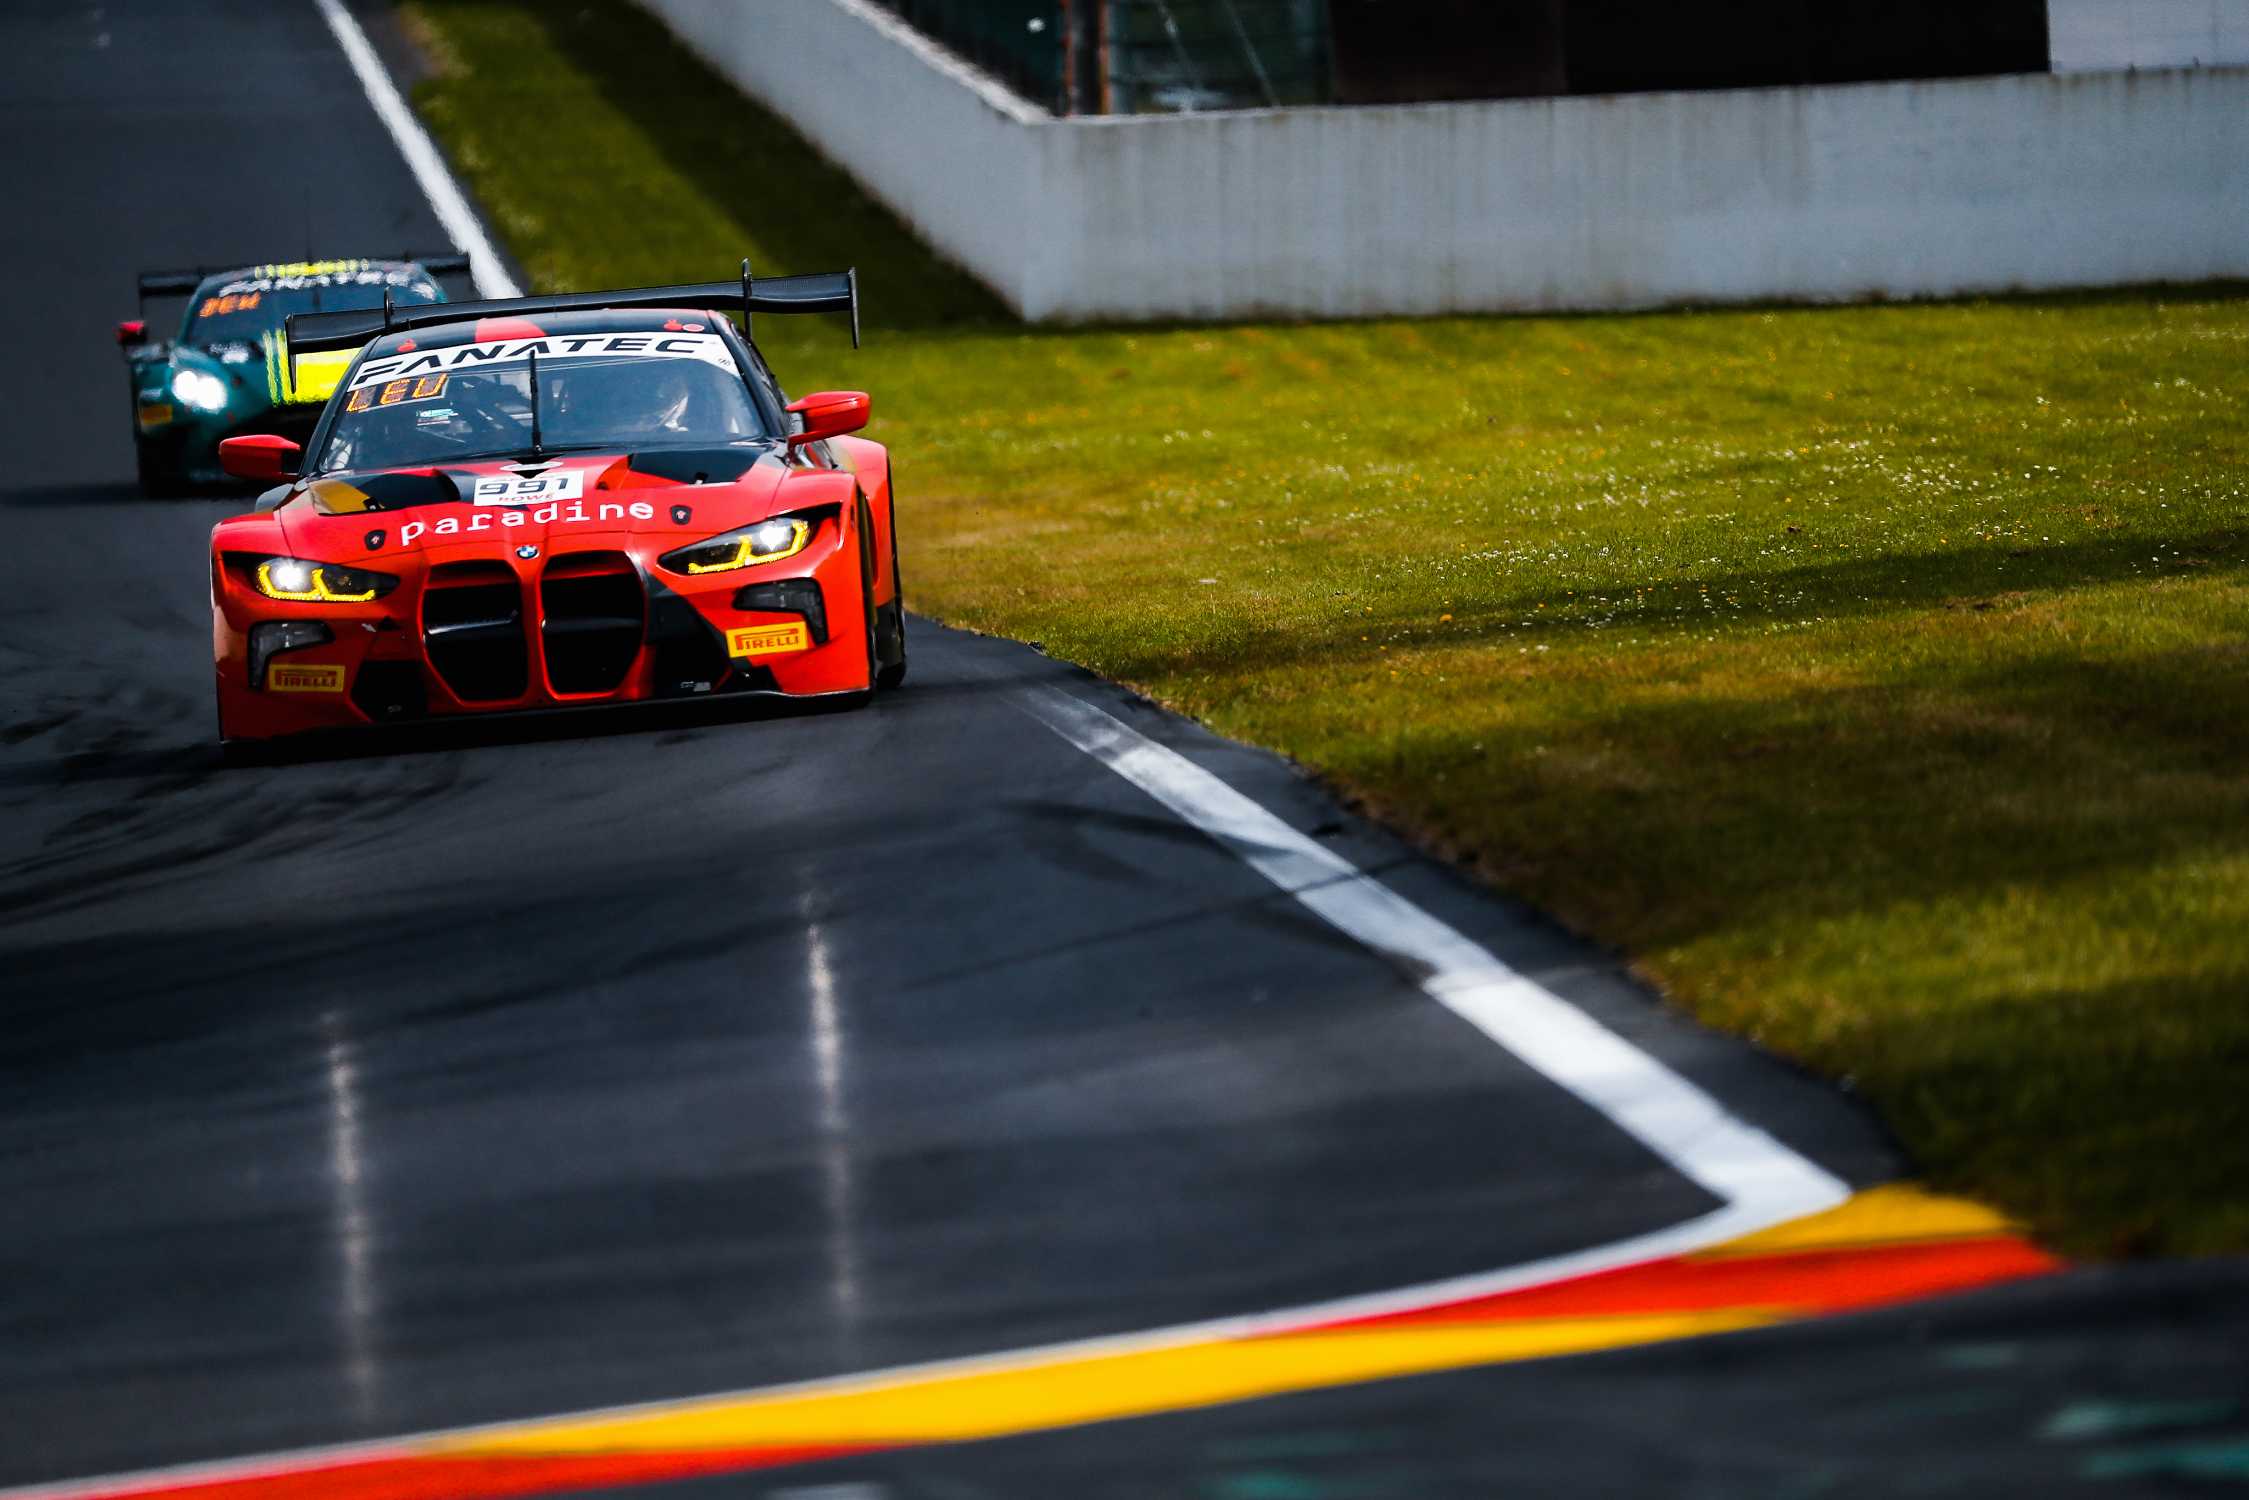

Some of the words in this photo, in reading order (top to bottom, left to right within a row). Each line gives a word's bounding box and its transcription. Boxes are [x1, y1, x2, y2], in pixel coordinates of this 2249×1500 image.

[353, 338, 704, 385] FANATEC
[479, 478, 568, 495] 991
[400, 501, 653, 546] paradine
[735, 628, 799, 650] PIRELLI
